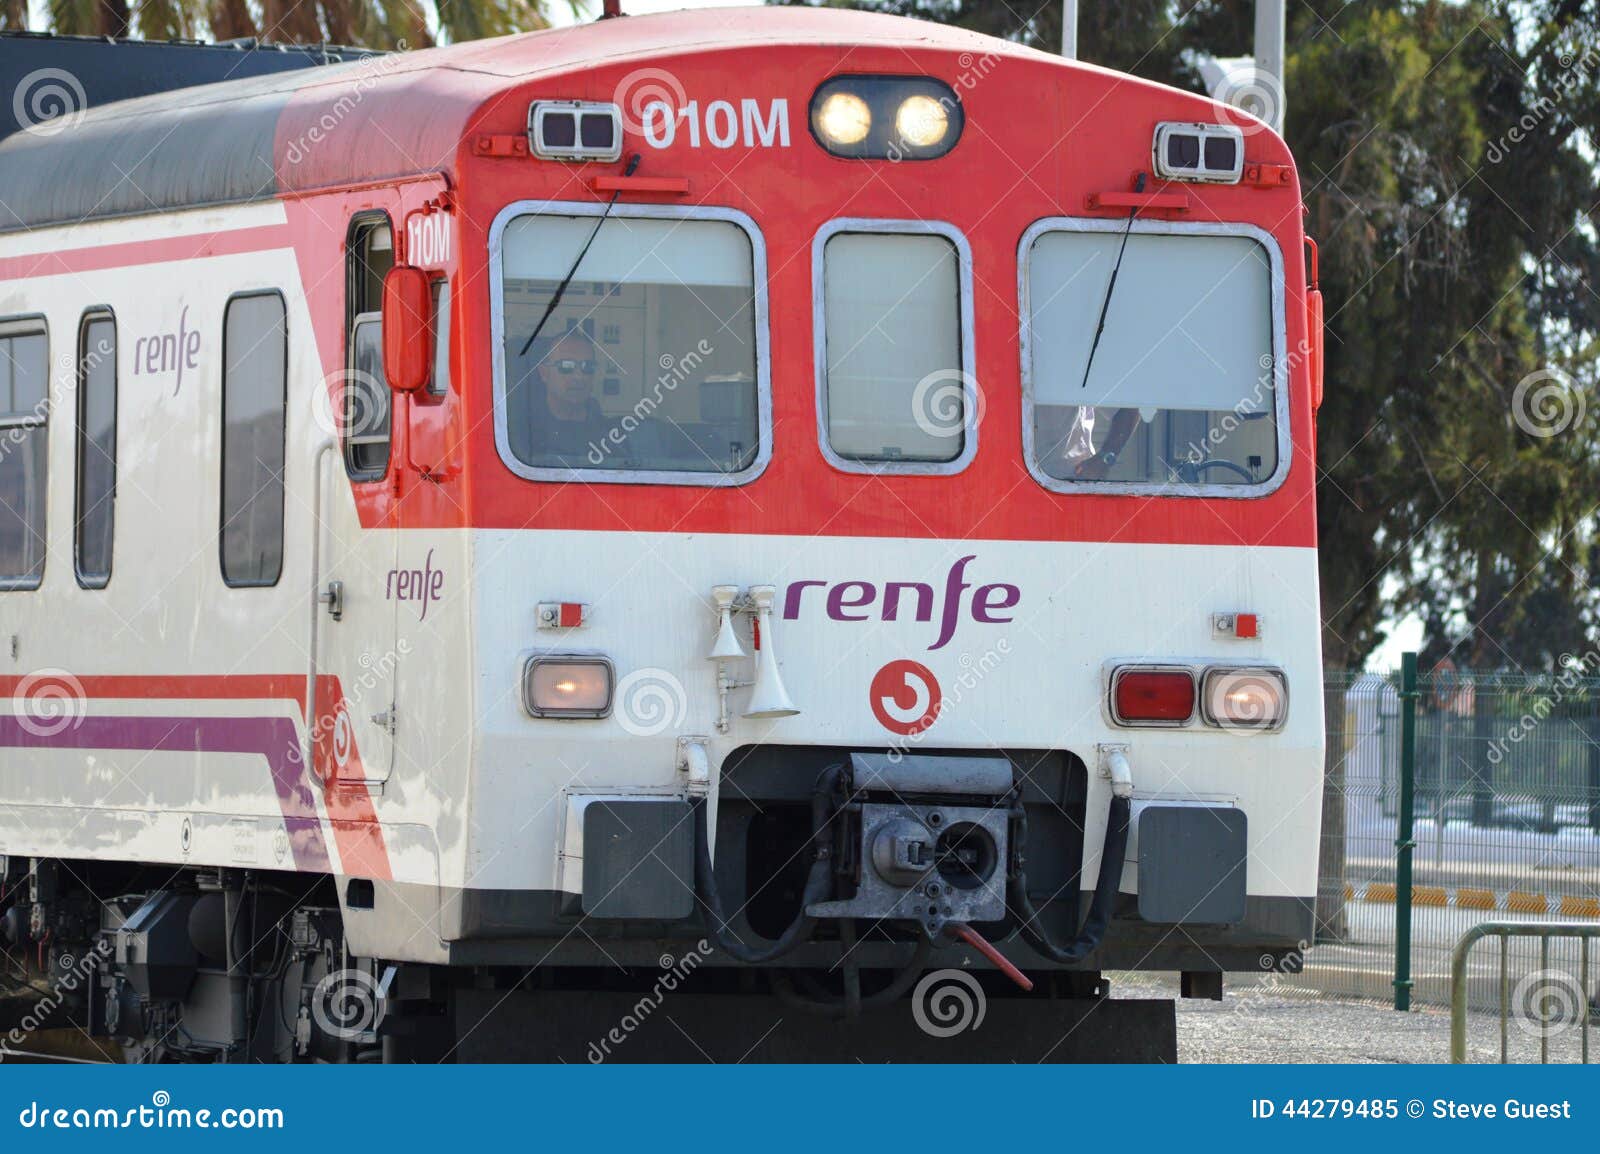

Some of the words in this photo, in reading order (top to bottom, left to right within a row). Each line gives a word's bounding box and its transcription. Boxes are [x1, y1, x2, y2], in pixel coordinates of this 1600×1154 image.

[642, 98, 791, 149] 010M
[134, 304, 201, 397] renfe
[386, 548, 443, 622] renfe
[783, 554, 1021, 651] renfe
